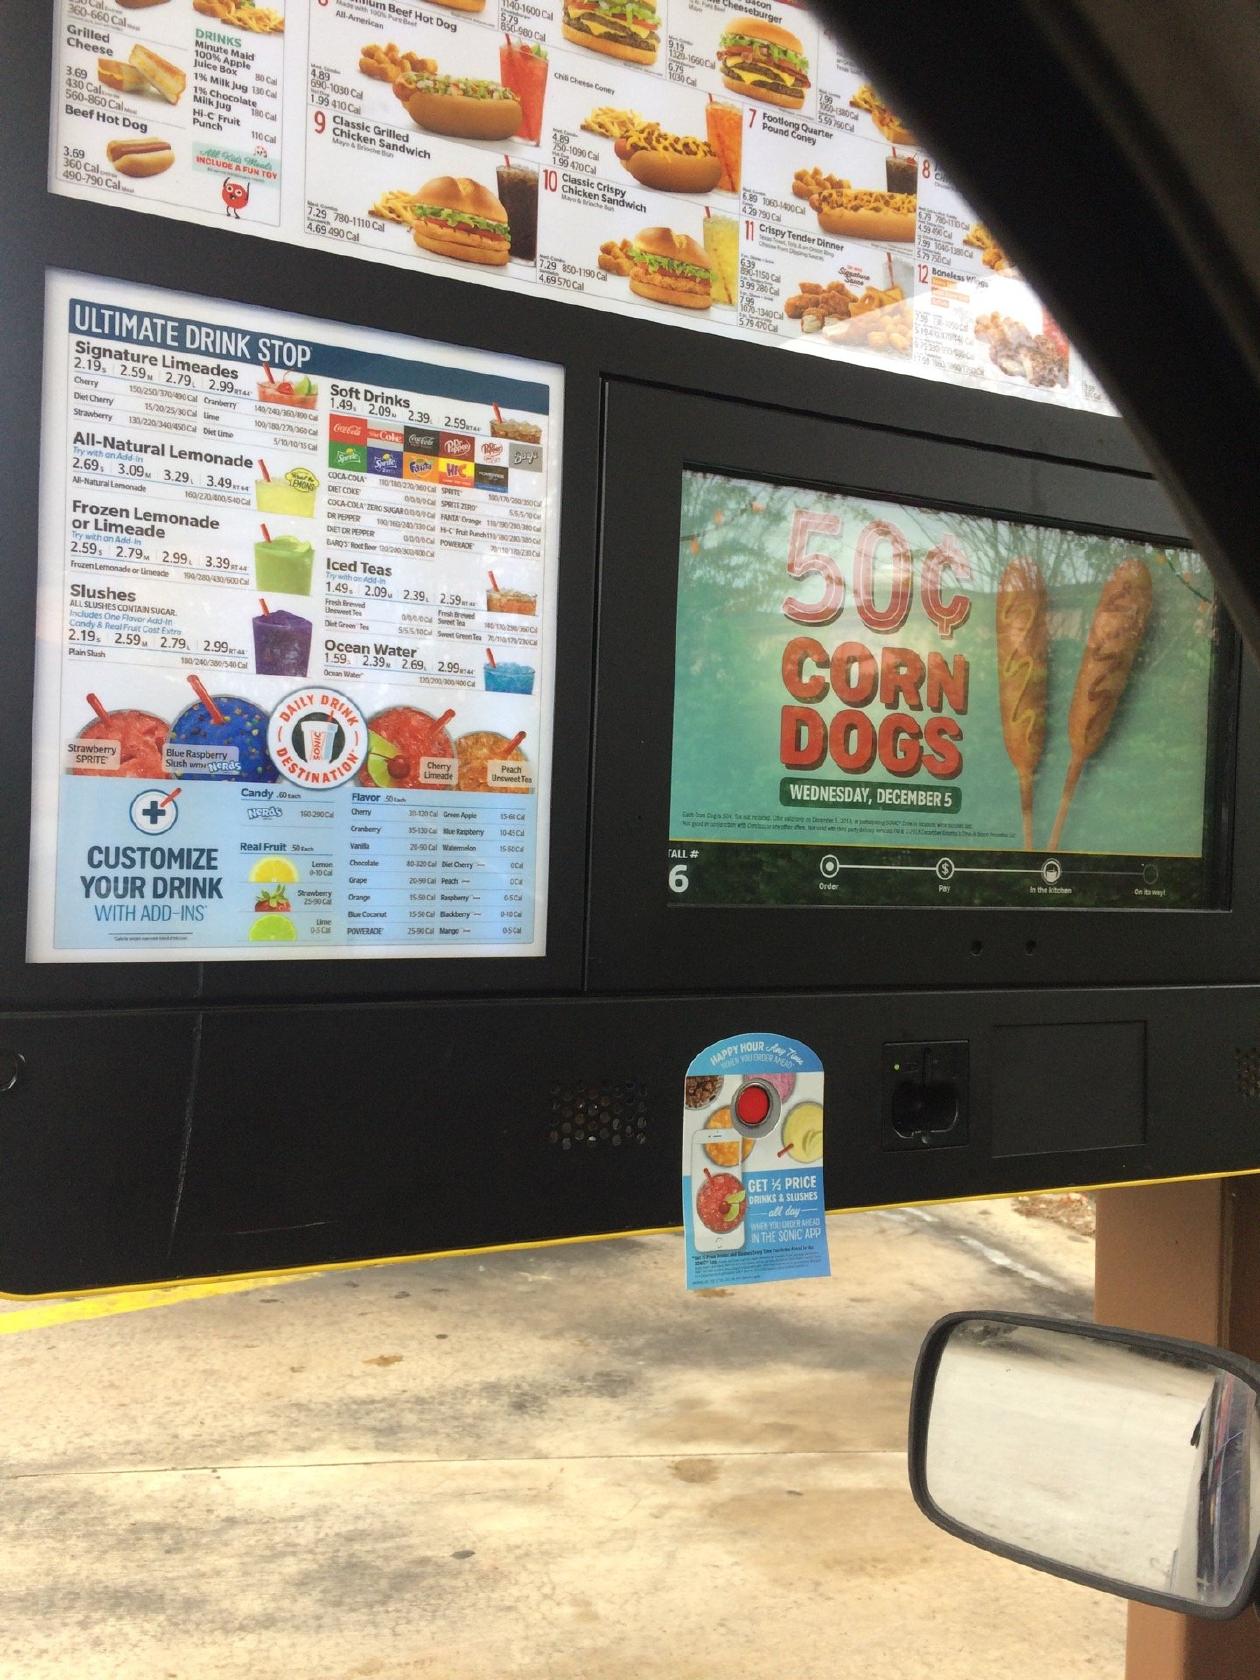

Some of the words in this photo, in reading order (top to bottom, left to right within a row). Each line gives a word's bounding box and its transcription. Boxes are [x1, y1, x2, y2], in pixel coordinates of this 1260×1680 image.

[389, 4, 414, 20] Beef
[415, 10, 435, 25] Hot
[436, 16, 458, 33] Dog
[722, 0, 783, 25] Cheeseburger
[67, 24, 110, 44] Grilled
[195, 28, 242, 48] DRINKS
[67, 37, 114, 57] Cheese
[195, 40, 229, 56] Minute
[230, 48, 255, 61] Maid
[194, 50, 221, 64] 100%
[223, 57, 251, 72] Apple
[194, 59, 218, 73] Juice
[219, 64, 238, 77] Box
[66, 66, 89, 79] 3.69
[310, 69, 331, 81] 4.89
[209, 75, 230, 89] Milk
[231, 80, 249, 93] Jug
[193, 94, 214, 108] Milk
[215, 99, 232, 112] Jug
[208, 88, 257, 108] Chocolate
[65, 104, 95, 120] Beef
[96, 110, 120, 126] Hot
[122, 117, 148, 134] Dog
[192, 108, 214, 120] Hi-C
[217, 114, 241, 127] Fruit
[193, 118, 223, 133] Punch
[313, 110, 326, 135] 9
[748, 108, 757, 129] 7
[762, 112, 799, 132] Footlong
[800, 120, 834, 141] Quarter
[332, 115, 371, 132] Classic
[373, 125, 410, 143] Grilled
[762, 123, 789, 139] Pound
[790, 130, 818, 147] Coney
[63, 146, 85, 159] 3.69
[332, 127, 376, 147] Chicken
[378, 139, 431, 161] Sandwich
[196, 156, 234, 173] INCLUDE
[261, 170, 278, 181] TOY
[922, 159, 931, 180] 8
[542, 169, 558, 193] 10
[561, 173, 594, 191] Classic
[595, 181, 626, 199] Crispy
[561, 185, 599, 202] Chicken
[600, 193, 646, 214] Sandwich
[306, 222, 327, 235] 4.69
[744, 220, 754, 242] 11
[758, 223, 782, 241] Crispy
[783, 229, 814, 247] Tender
[816, 235, 845, 252] Dinner
[917, 263, 929, 285] 12
[931, 267, 967, 283] Boneless
[74, 304, 179, 348] ULTIMATE
[185, 324, 252, 361] DRINK
[257, 338, 313, 370] STOP
[75, 340, 159, 368] Signature
[161, 354, 240, 380] Limeades
[74, 376, 99, 390] Cherry
[74, 391, 86, 401] Diet
[87, 393, 114, 407] Cherry
[203, 396, 237, 411] Cranberry
[330, 384, 361, 401] Soft
[364, 389, 411, 409] Drinks
[73, 407, 114, 422] Strawberry
[203, 411, 220, 422] Lime
[73, 431, 166, 460] All-Natural
[168, 444, 254, 470] Lemonade
[72, 476, 110, 488] All-Natural
[110, 481, 147, 494] Lemonade
[72, 500, 131, 519] Frozen
[134, 507, 220, 530] Lemonade
[72, 519, 89, 531] or
[94, 518, 166, 539] Limeade
[326, 557, 358, 574] Iced
[360, 561, 393, 579] Teas
[783, 508, 972, 641] 50¢
[70, 583, 137, 603] Slushes
[68, 647, 86, 658] Plain
[86, 649, 107, 659] Slush
[324, 639, 371, 658] Ocean
[373, 643, 418, 661] Water
[781, 635, 970, 716] CORN
[279, 694, 315, 723] DAILY
[320, 693, 360, 727] DRINK
[67, 742, 118, 760] Strawberry
[780, 704, 964, 781] DOGS
[76, 754, 104, 767] SPRITE
[166, 747, 185, 759] Blue
[186, 749, 228, 763] Raspberry
[276, 747, 359, 785] DESTINATION
[423, 769, 454, 782] Limeade
[426, 760, 452, 773] Cherry
[500, 764, 523, 775] Peach
[352, 793, 381, 803] Flavor
[789, 783, 874, 805] WEDNESDAY,
[876, 787, 942, 807] DECEMBER
[943, 793, 953, 807] 5
[351, 807, 372, 818] Cherry
[351, 825, 381, 835] Cranberry
[240, 842, 262, 853] Real
[262, 843, 288, 854] Fruit
[350, 842, 370, 852] Vanilla
[442, 844, 478, 854] Watermelon
[689, 849, 700, 859] #
[87, 845, 219, 872] CUSTOMIZE
[349, 859, 380, 868] Chocolate
[79, 875, 147, 900] YOUR
[152, 875, 224, 900] DRINK
[348, 876, 368, 887] Grape
[668, 864, 690, 893] 6
[818, 882, 840, 891] Order
[348, 893, 371, 904] Orange
[440, 893, 470, 904] Raspberry
[938, 884, 951, 894] Pay
[1029, 886, 1037, 894] In
[1037, 886, 1048, 894] the
[1048, 886, 1073, 895] kitchen
[94, 904, 137, 922] WITH
[139, 905, 205, 923] ADD-INS
[710, 1044, 740, 1067] HAPPY
[740, 1041, 765, 1054] HOUR
[765, 1042, 787, 1058] Any
[786, 1047, 805, 1067] Time
[748, 1178, 769, 1193] GET
[785, 1175, 818, 1191] PRICE
[748, 1193, 777, 1206] DRINKS
[786, 1190, 819, 1203] SLUSHES
[768, 1205, 783, 1218] all
[785, 1205, 801, 1218] day
[751, 1233, 761, 1245] IN
[761, 1231, 778, 1244] THE
[779, 1228, 803, 1244] SONIC
[804, 1227, 822, 1241] APP
